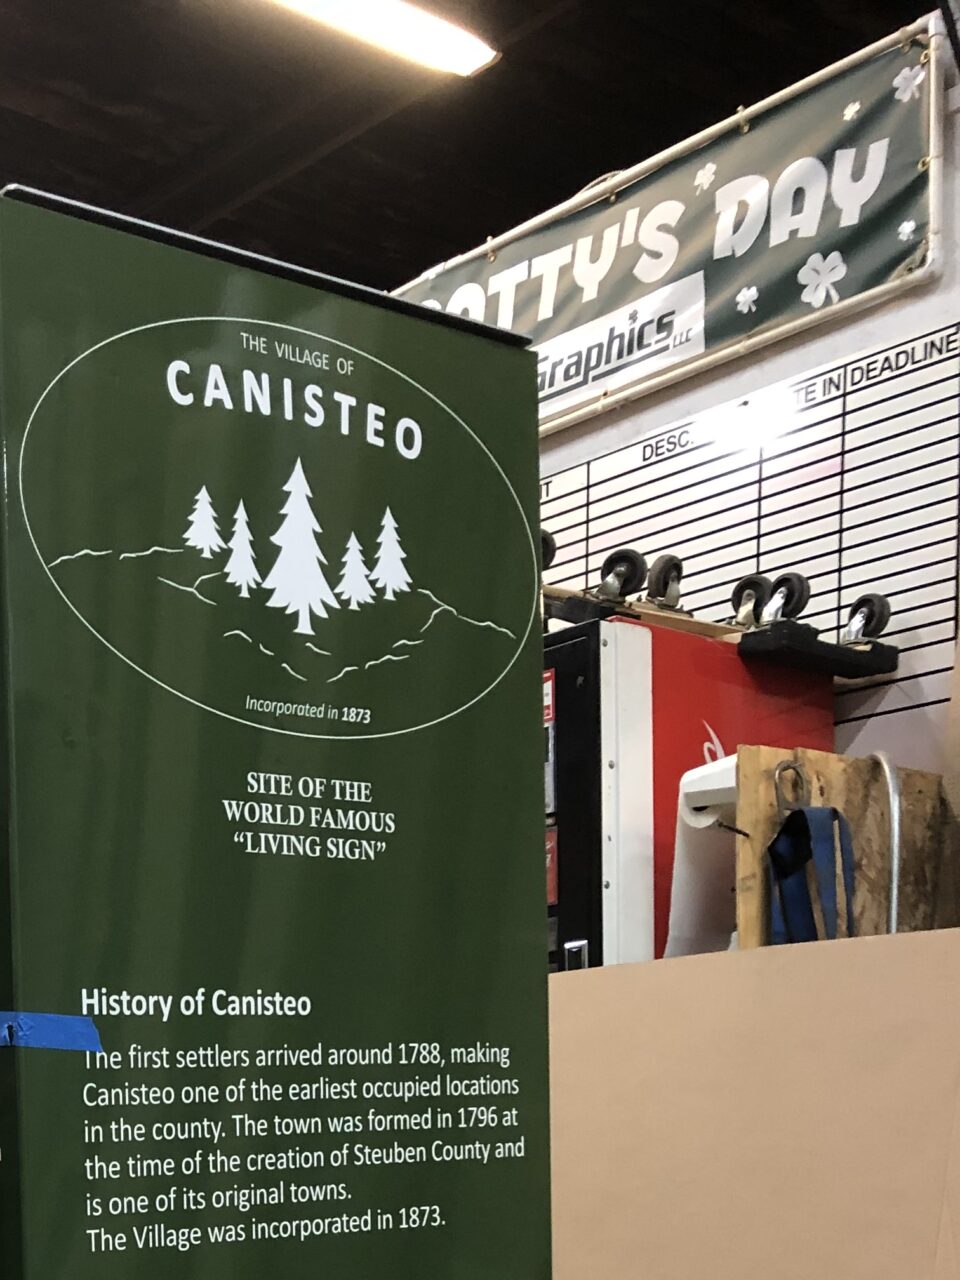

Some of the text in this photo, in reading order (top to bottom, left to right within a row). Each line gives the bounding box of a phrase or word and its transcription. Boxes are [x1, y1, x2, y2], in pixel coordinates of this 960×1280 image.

[713, 138, 890, 259] DAY
[240, 332, 355, 376] THE VILLAGE OF
[673, 327, 693, 348] LLC
[850, 331, 959, 387] DEADLINE
[793, 372, 842, 404] TE IN
[166, 359, 423, 460] CANISTEO
[245, 695, 371, 724] Incorporated in 1873
[247, 771, 373, 803] SITE OF THE
[222, 799, 395, 833] WORLD FAMOUS
[81, 987, 312, 1022] History of Canisteo
[85, 1041, 510, 1069] The first settlers arrived around 1788, making
[83, 1074, 520, 1107] Canisteo one of the earliest occupied locations
[84, 1106, 519, 1144] in the county. The town was formed in 1796 at
[84, 1136, 525, 1180] the time of the creation of Steuben County and
[86, 1181, 352, 1216] is one of its original towns.
[86, 1205, 446, 1252] The Village was incorporated in 1873.
